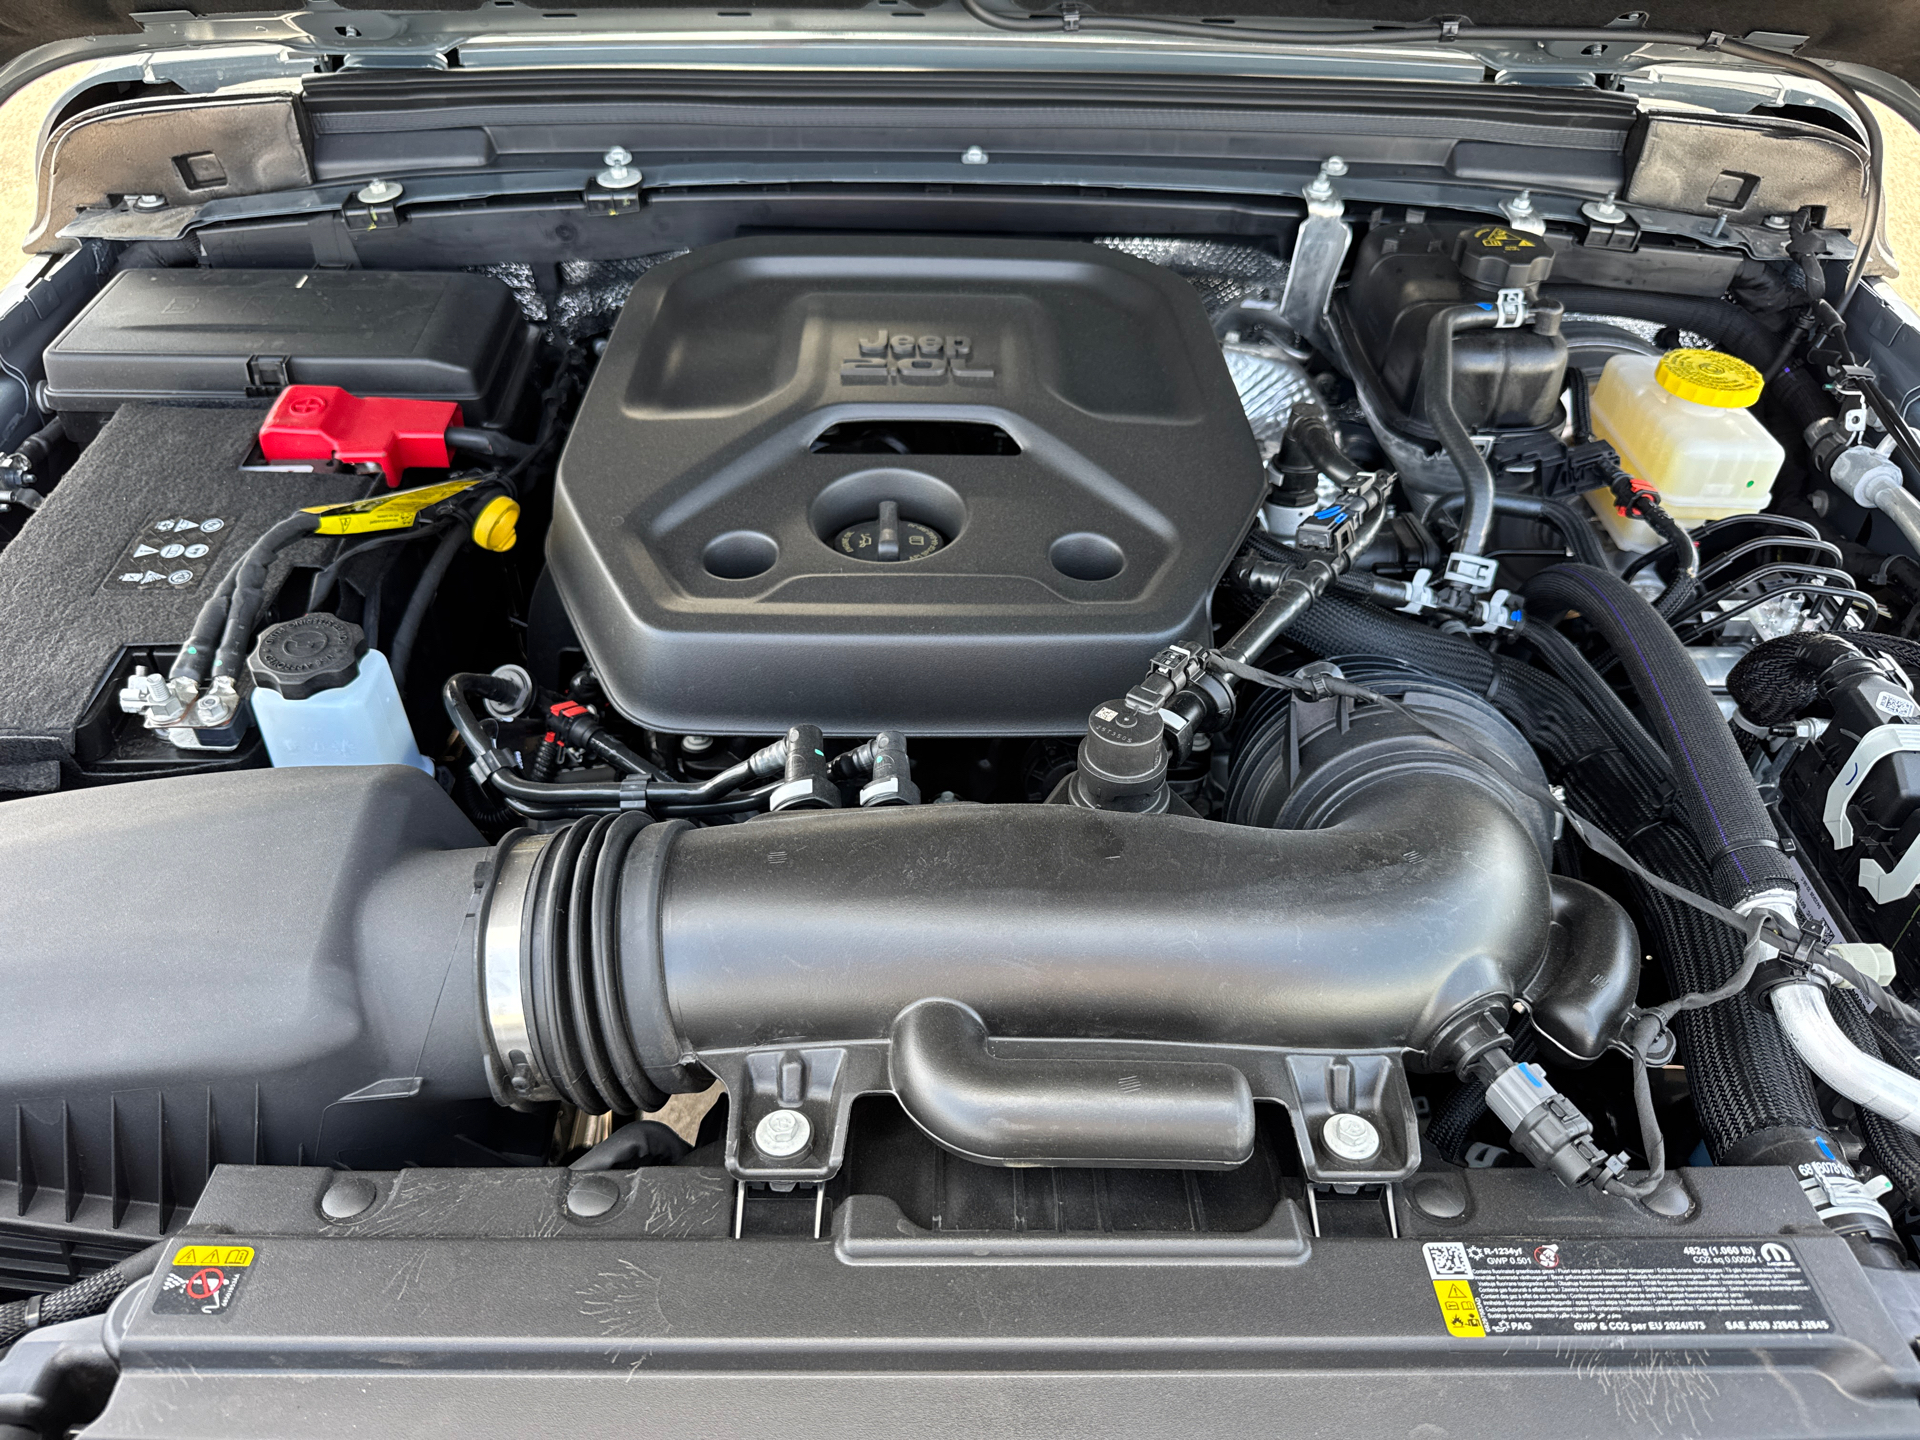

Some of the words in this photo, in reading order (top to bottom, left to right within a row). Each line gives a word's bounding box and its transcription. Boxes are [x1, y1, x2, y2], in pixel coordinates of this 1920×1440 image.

[858, 329, 972, 357] Jeep
[840, 358, 995, 379] 2.0L
[1484, 1247, 1522, 1257] R-1234yf
[1683, 1246, 1709, 1257] 482g
[1709, 1246, 1739, 1257] (1.060
[1740, 1246, 1756, 1256] lb)
[1486, 1257, 1507, 1265] GWP
[1509, 1257, 1532, 1265] 0.501
[1692, 1256, 1712, 1264] CO2
[1511, 1322, 1533, 1331] PAG
[1573, 1322, 1596, 1331] GWP
[1608, 1322, 1630, 1331] CO2
[1631, 1323, 1648, 1332] per
[1649, 1321, 1663, 1330] EU
[1725, 1321, 1747, 1330] SAE
